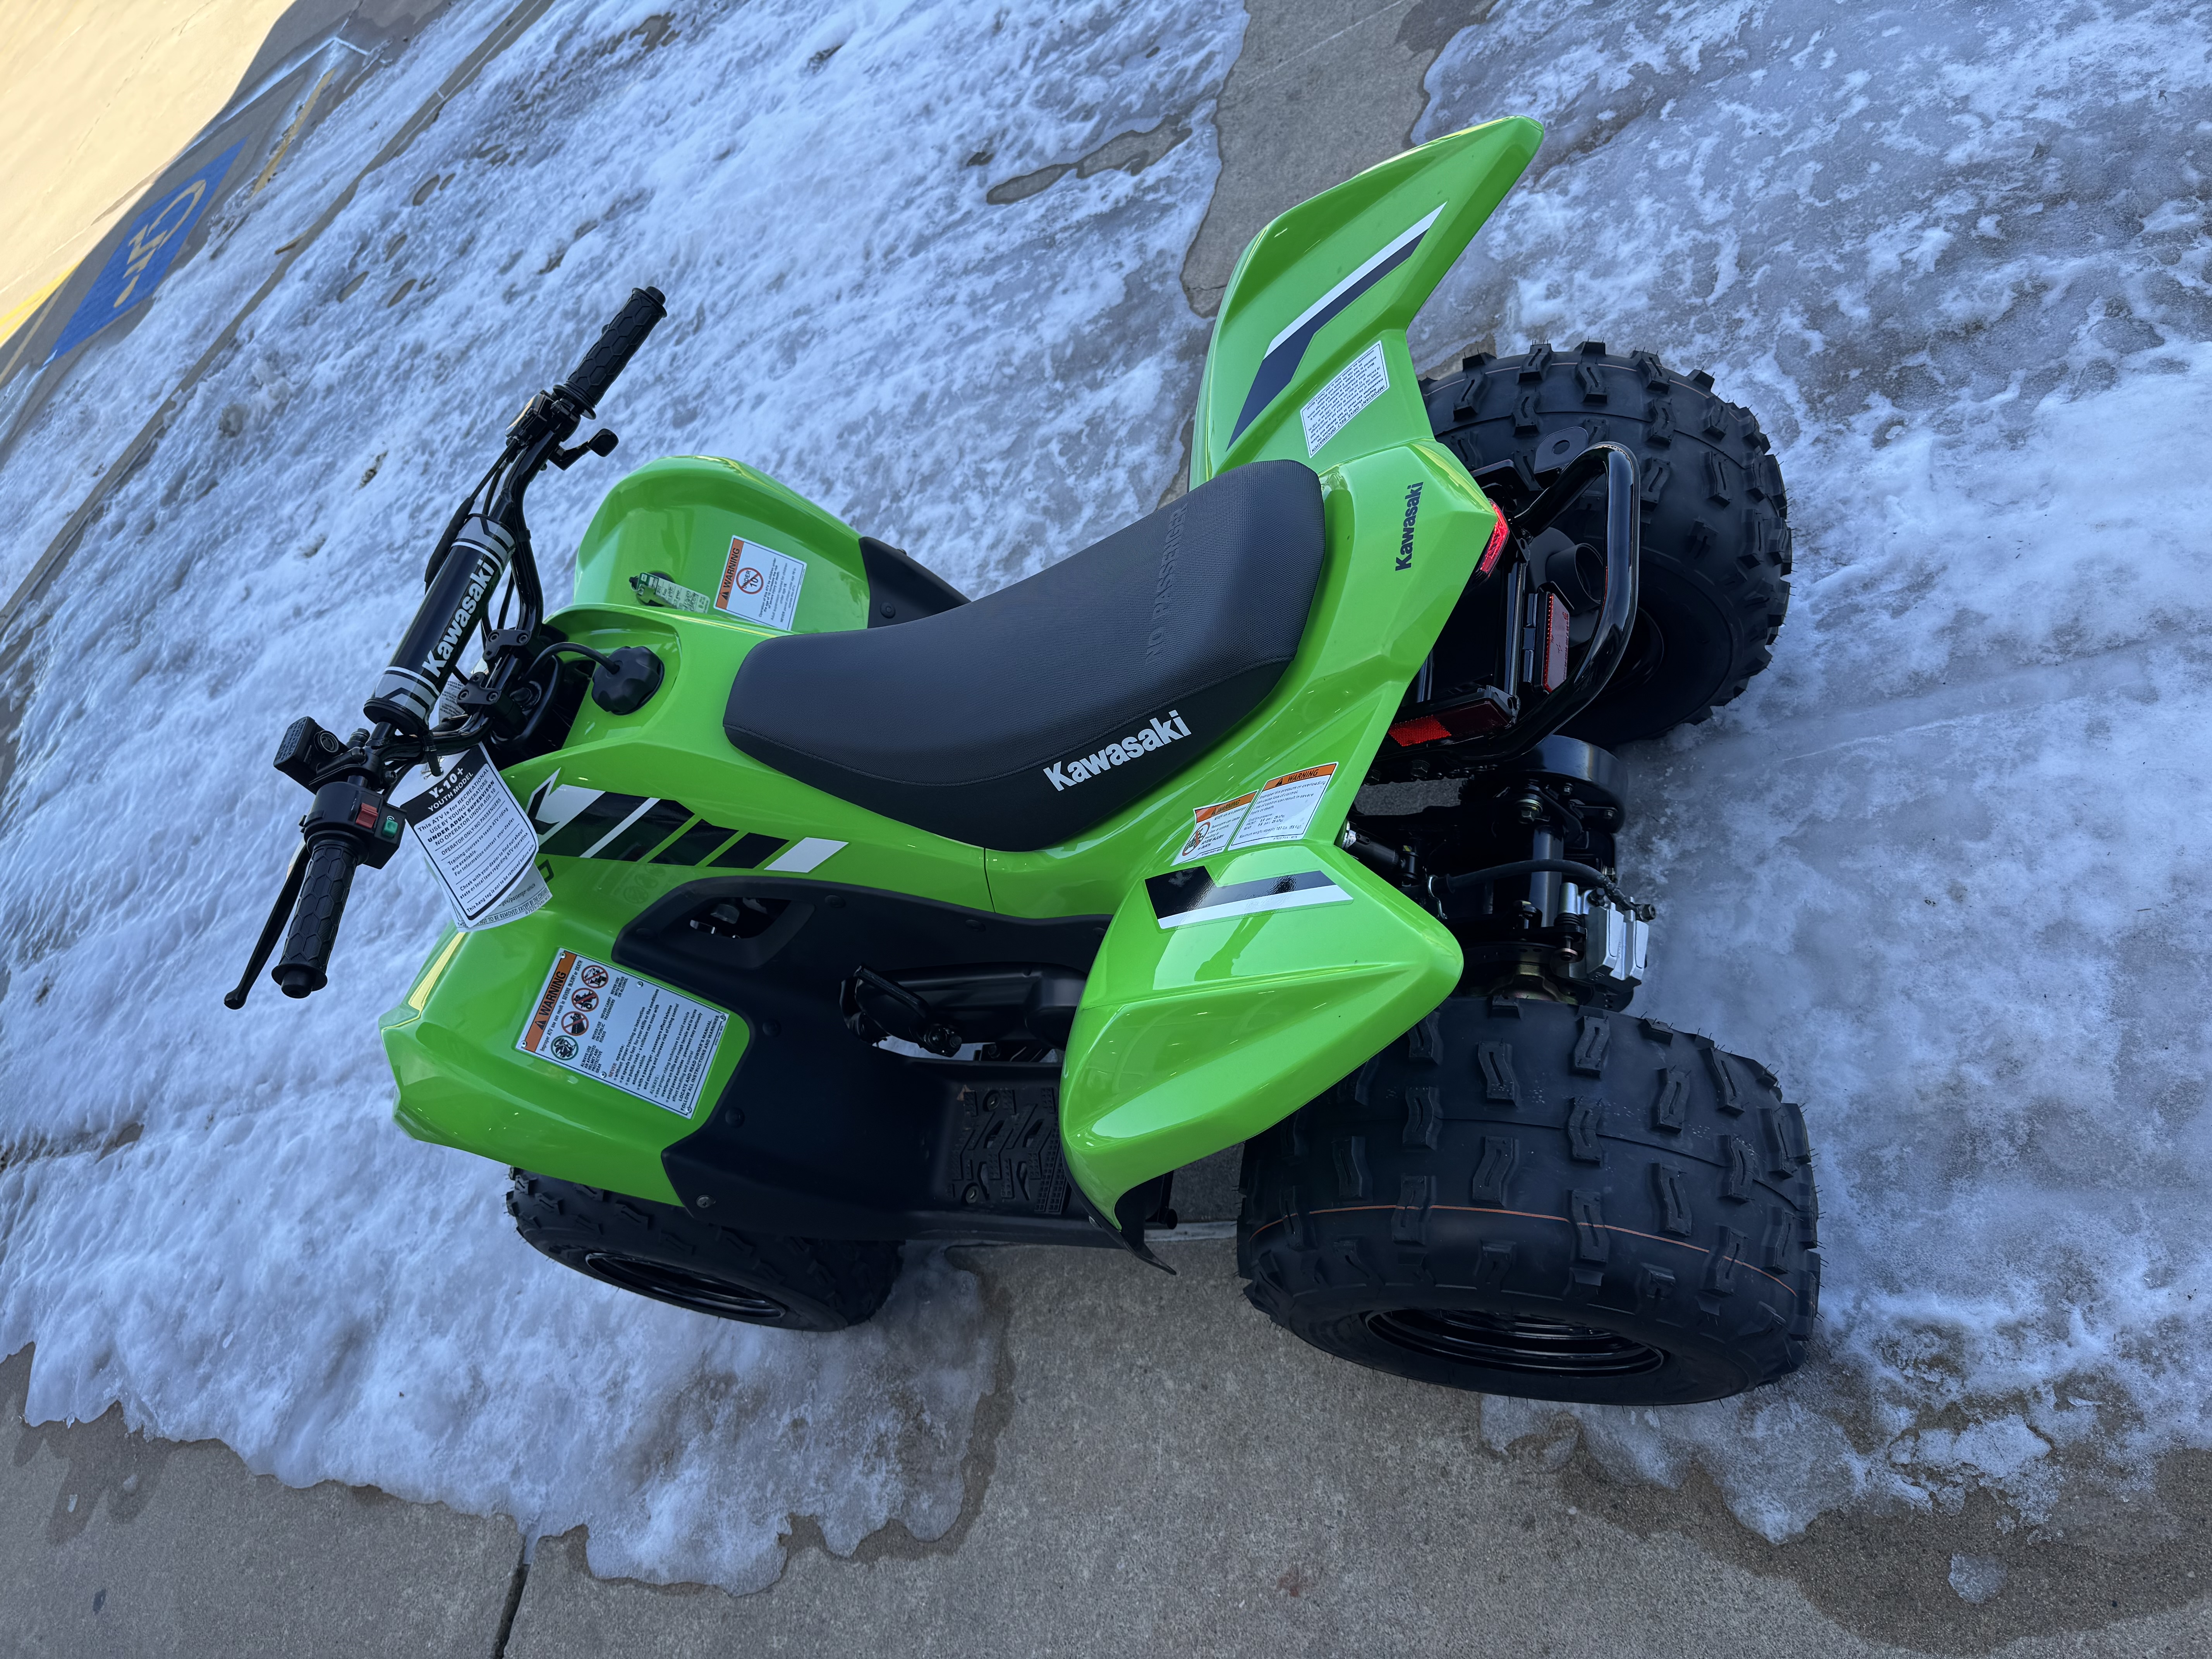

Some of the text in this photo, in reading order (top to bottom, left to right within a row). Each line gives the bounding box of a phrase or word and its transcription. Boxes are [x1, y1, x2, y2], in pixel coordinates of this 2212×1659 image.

[1395, 482, 1424, 571] Kawasaki
[723, 548, 740, 589] WARNING
[749, 576, 759, 587] 10
[422, 559, 495, 678] Kawasaki
[1043, 709, 1192, 791] Kawasaki
[428, 768, 463, 798] Y-10+
[428, 772, 473, 811] YOUTH MODEL
[1287, 768, 1319, 783] WARNING
[417, 823, 431, 832] This
[432, 813, 443, 824] ATV
[457, 769, 489, 805] RECREATIONAL
[429, 824, 442, 833] USE
[441, 818, 448, 826] BY
[448, 804, 466, 820] YOUNG
[434, 838, 444, 846] NO
[444, 817, 470, 840] OPERATOR
[469, 802, 484, 819] UNDER
[483, 793, 492, 804] AGE
[500, 908, 519, 919] REMOVED
[539, 971, 567, 1018] WARNING
[591, 1028, 599, 1040] NEVER
[608, 1062, 617, 1078] NEVER
